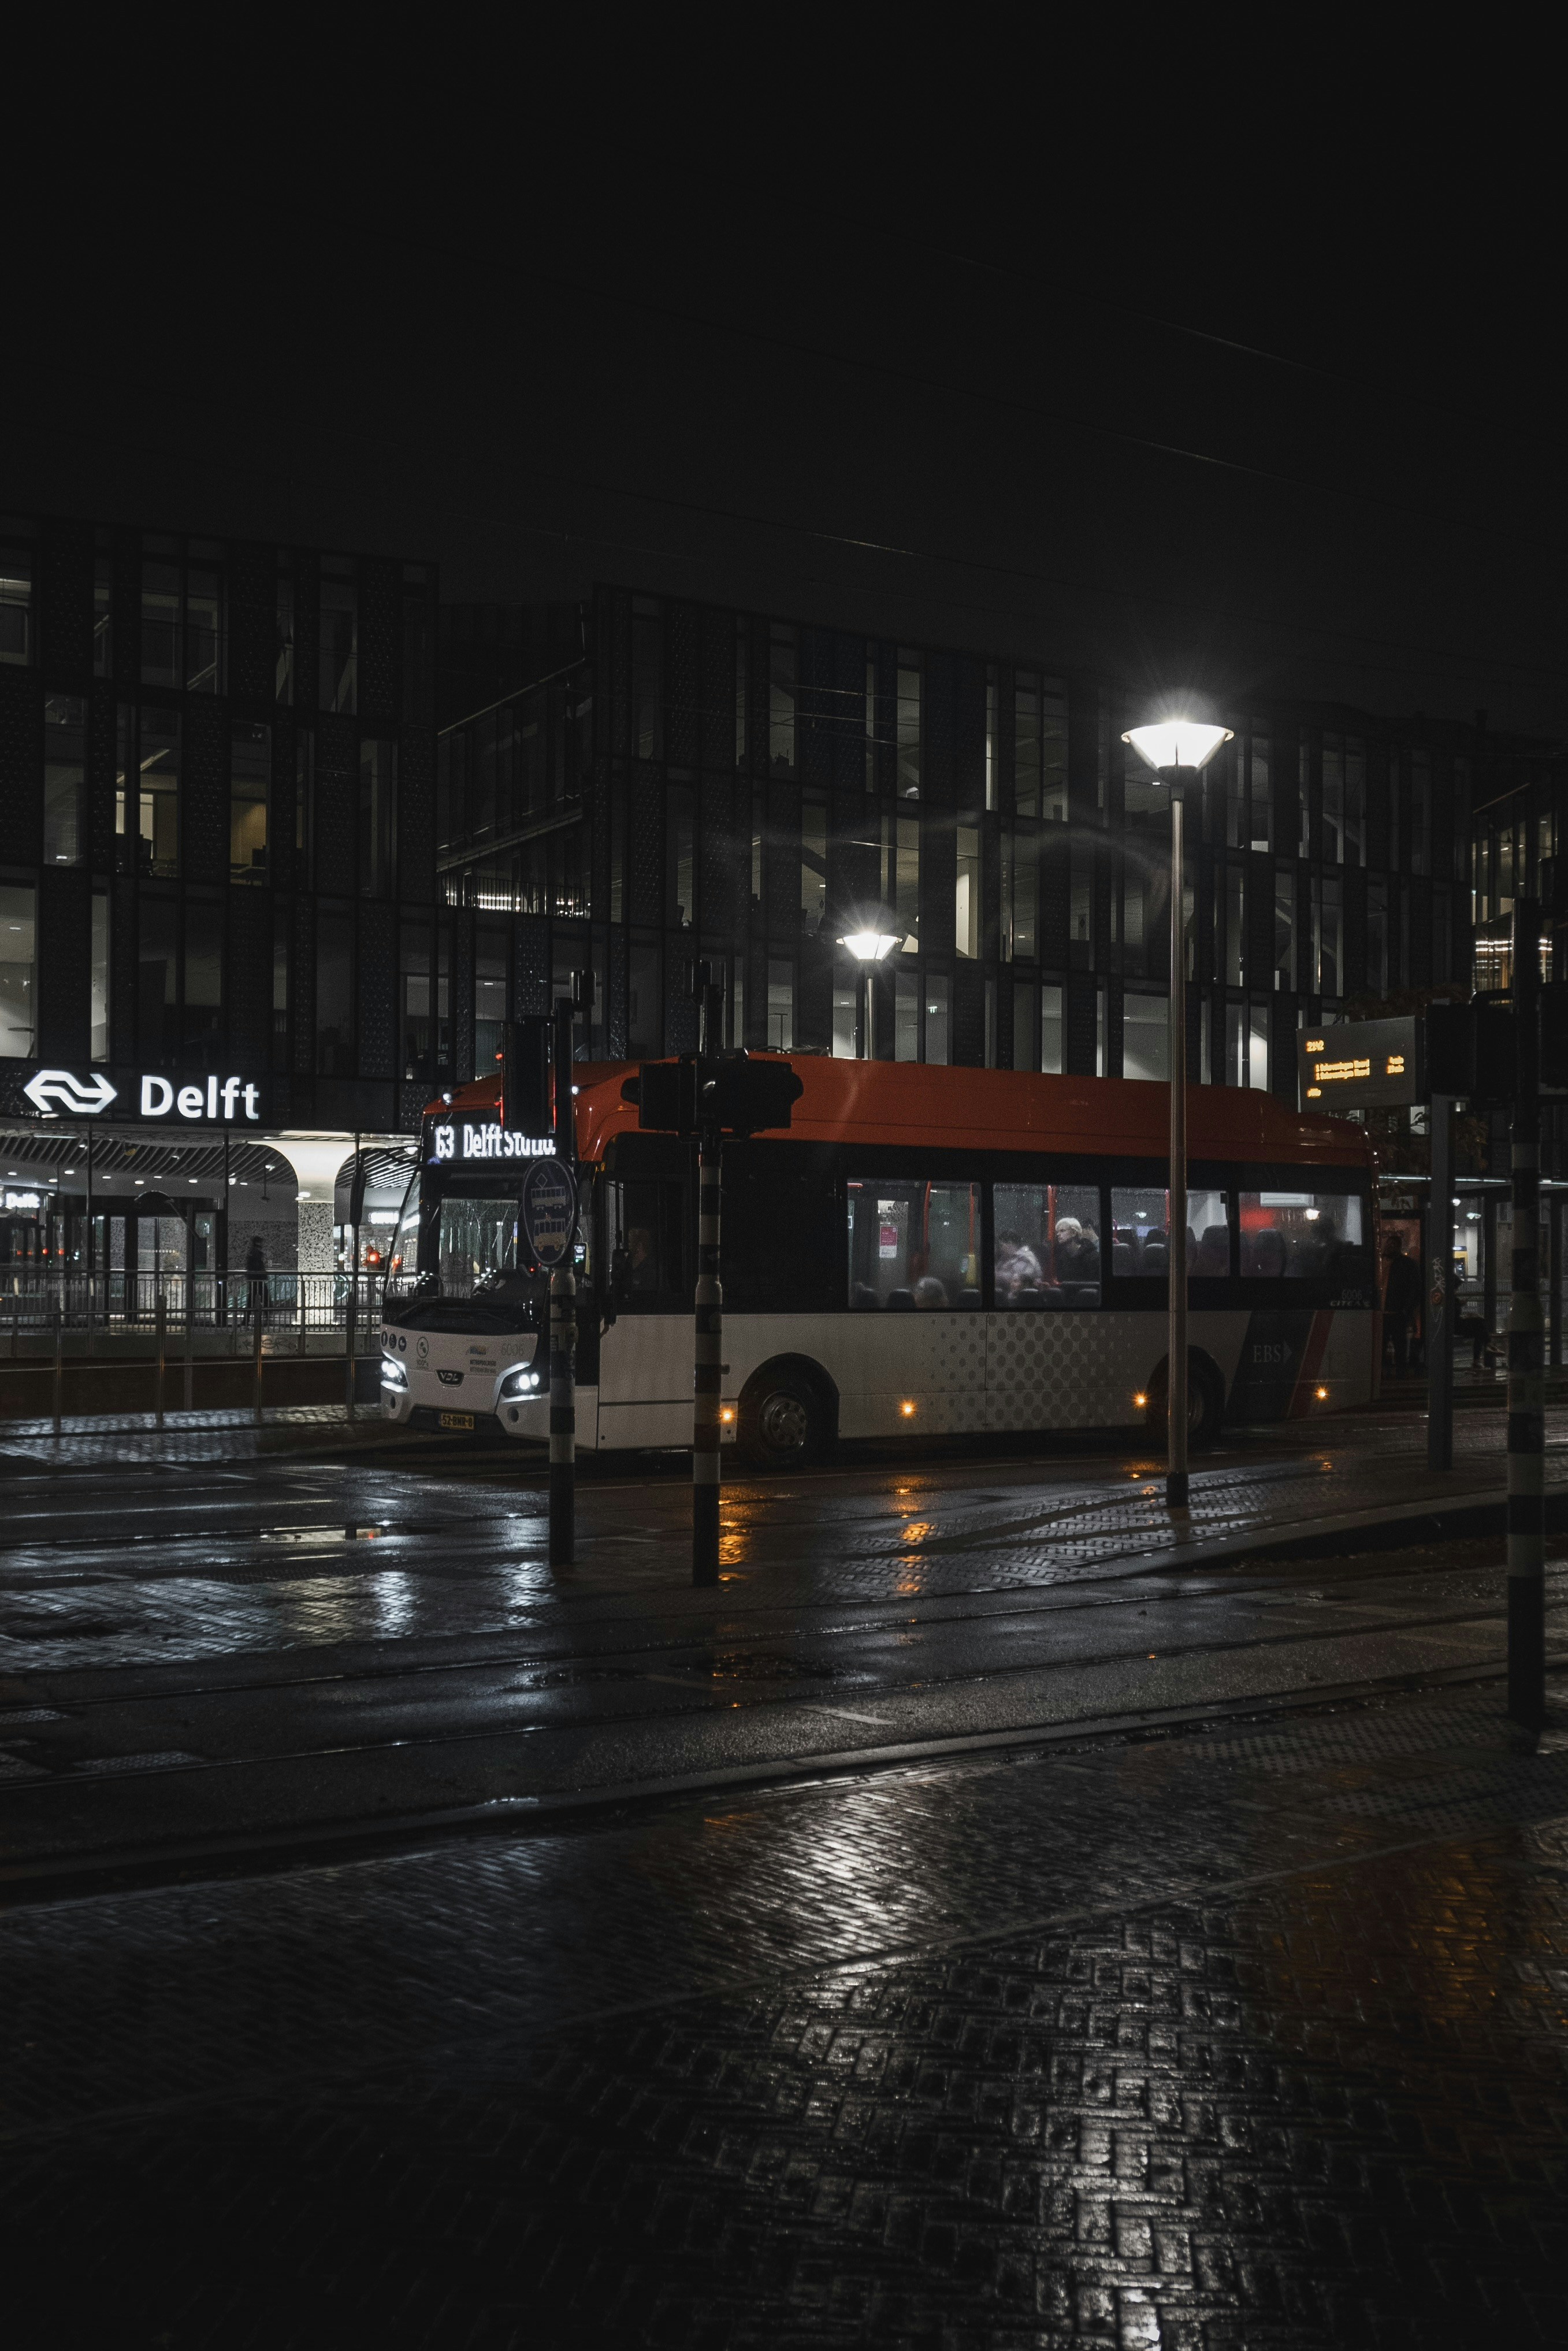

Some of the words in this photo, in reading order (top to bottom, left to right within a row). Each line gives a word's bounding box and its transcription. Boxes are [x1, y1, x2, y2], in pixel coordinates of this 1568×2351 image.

[141, 1075, 259, 1120] Delft
[436, 1125, 455, 1158] 63
[463, 1123, 503, 1157] Delft
[1253, 1344, 1281, 1363] EBS
[440, 1371, 459, 1382] VDL
